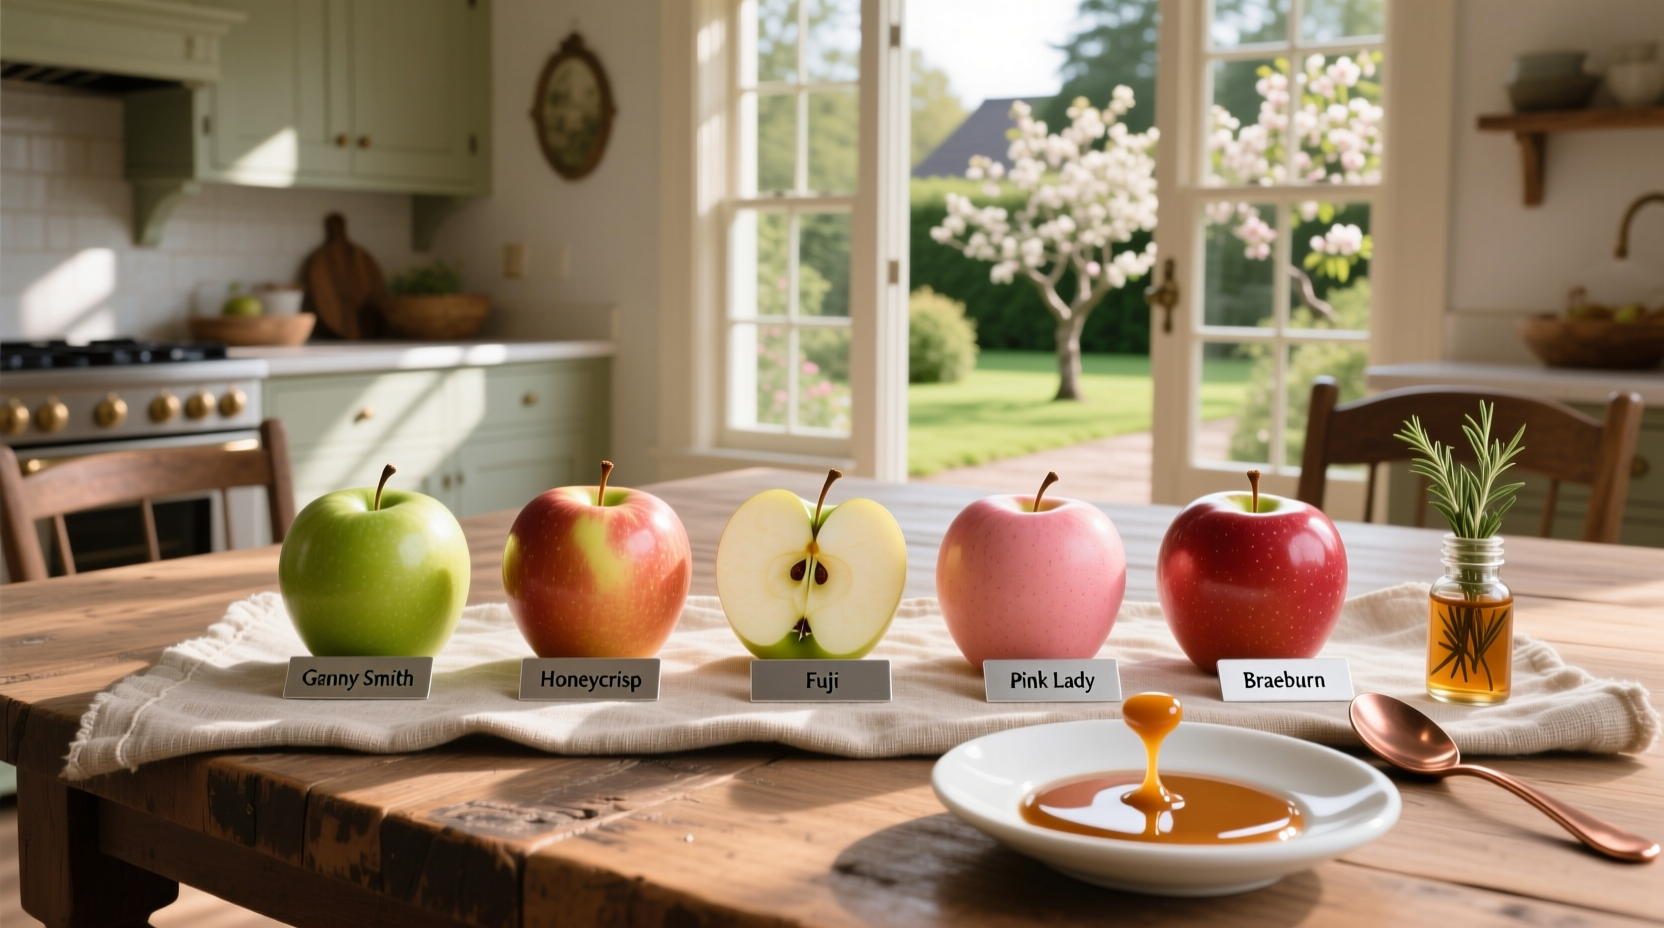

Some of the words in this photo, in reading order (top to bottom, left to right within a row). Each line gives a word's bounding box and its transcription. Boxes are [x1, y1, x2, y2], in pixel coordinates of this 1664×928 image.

[362, 668, 415, 687] Smith
[540, 670, 642, 693] Honeycrisp
[806, 671, 840, 695] Fuji
[1010, 670, 1049, 689] Pink
[1053, 670, 1095, 694] Lady
[1243, 670, 1326, 689] Braeburn
